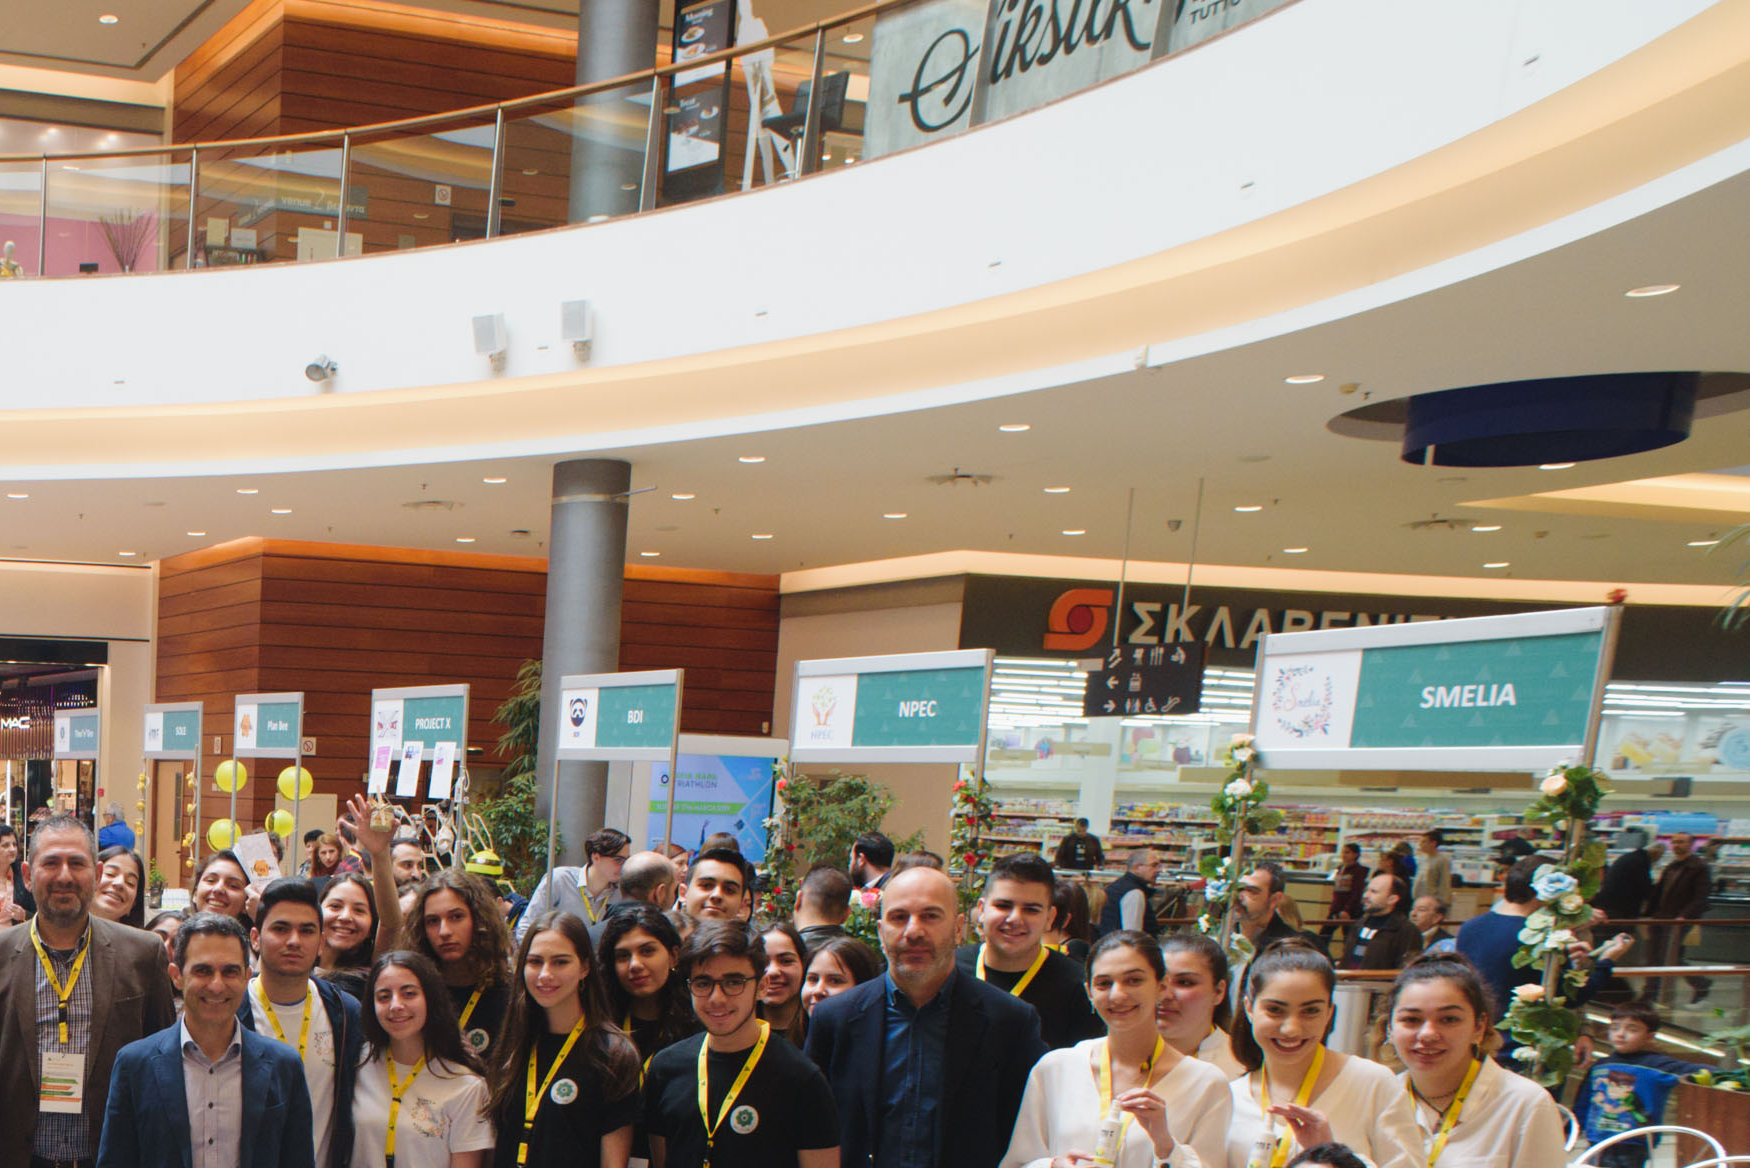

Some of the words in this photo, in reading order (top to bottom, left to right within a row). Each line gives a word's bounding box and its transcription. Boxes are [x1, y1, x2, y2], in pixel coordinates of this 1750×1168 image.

[1419, 682, 1517, 711] SMELIA
[898, 699, 938, 718] NPEC
[0, 715, 31, 730] MAC
[415, 717, 445, 730] PROJECT
[445, 717, 451, 729] X
[627, 709, 644, 724] BDI
[677, 779, 718, 789] RIATHLON
